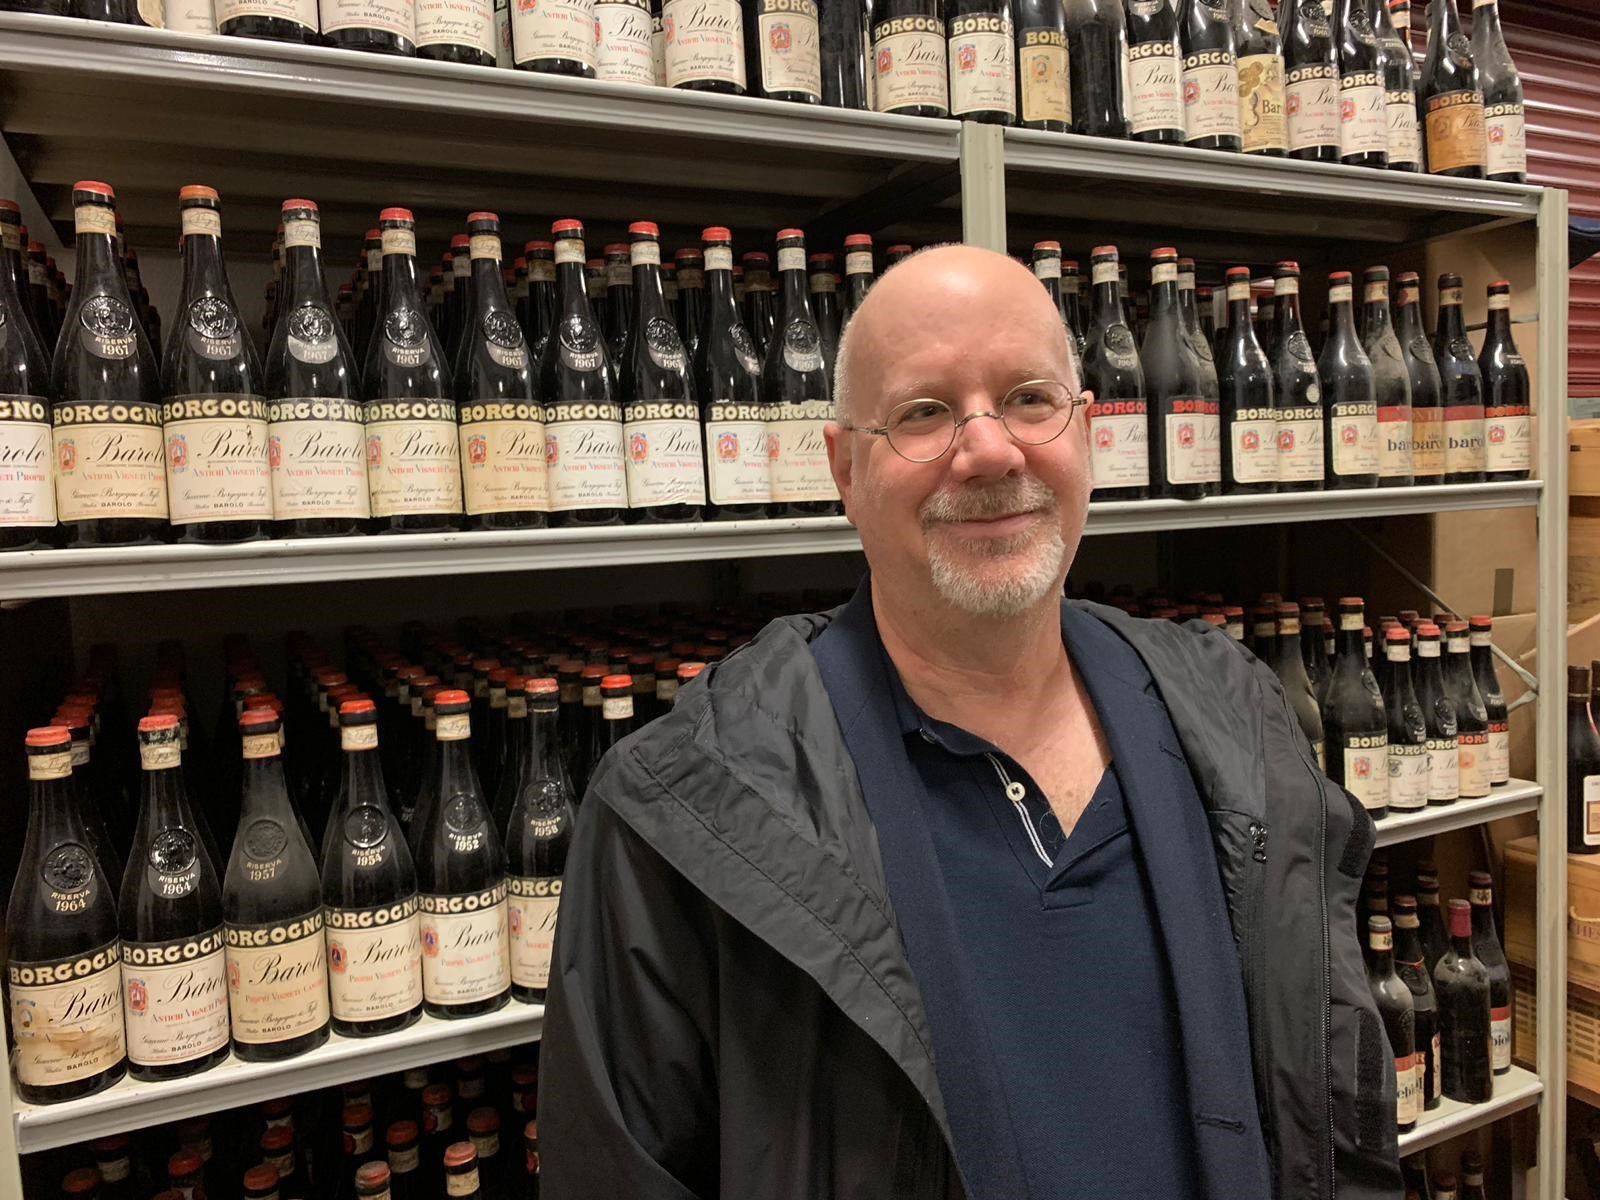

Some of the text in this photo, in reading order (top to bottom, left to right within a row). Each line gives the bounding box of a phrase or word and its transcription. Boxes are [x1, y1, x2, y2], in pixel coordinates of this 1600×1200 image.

[363, 12, 391, 21] BAROLO
[102, 344, 129, 355] 1967
[206, 344, 232, 355] 1967
[396, 353, 421, 364] 1967
[574, 358, 596, 369] 1967
[267, 403, 363, 422] ORGOGNO
[455, 839, 480, 851] 1952
[357, 854, 382, 866] 1954
[158, 872, 196, 883] RISERVA
[250, 868, 275, 881] 1957
[162, 882, 192, 895] 1964
[51, 889, 91, 900] RISERVA
[55, 899, 86, 912] 1964
[151, 1013, 184, 1023] ANTICHI
[262, 1023, 292, 1034] BAROLO
[171, 1040, 202, 1052] BAROLO
[66, 1057, 99, 1071] BAROLO
